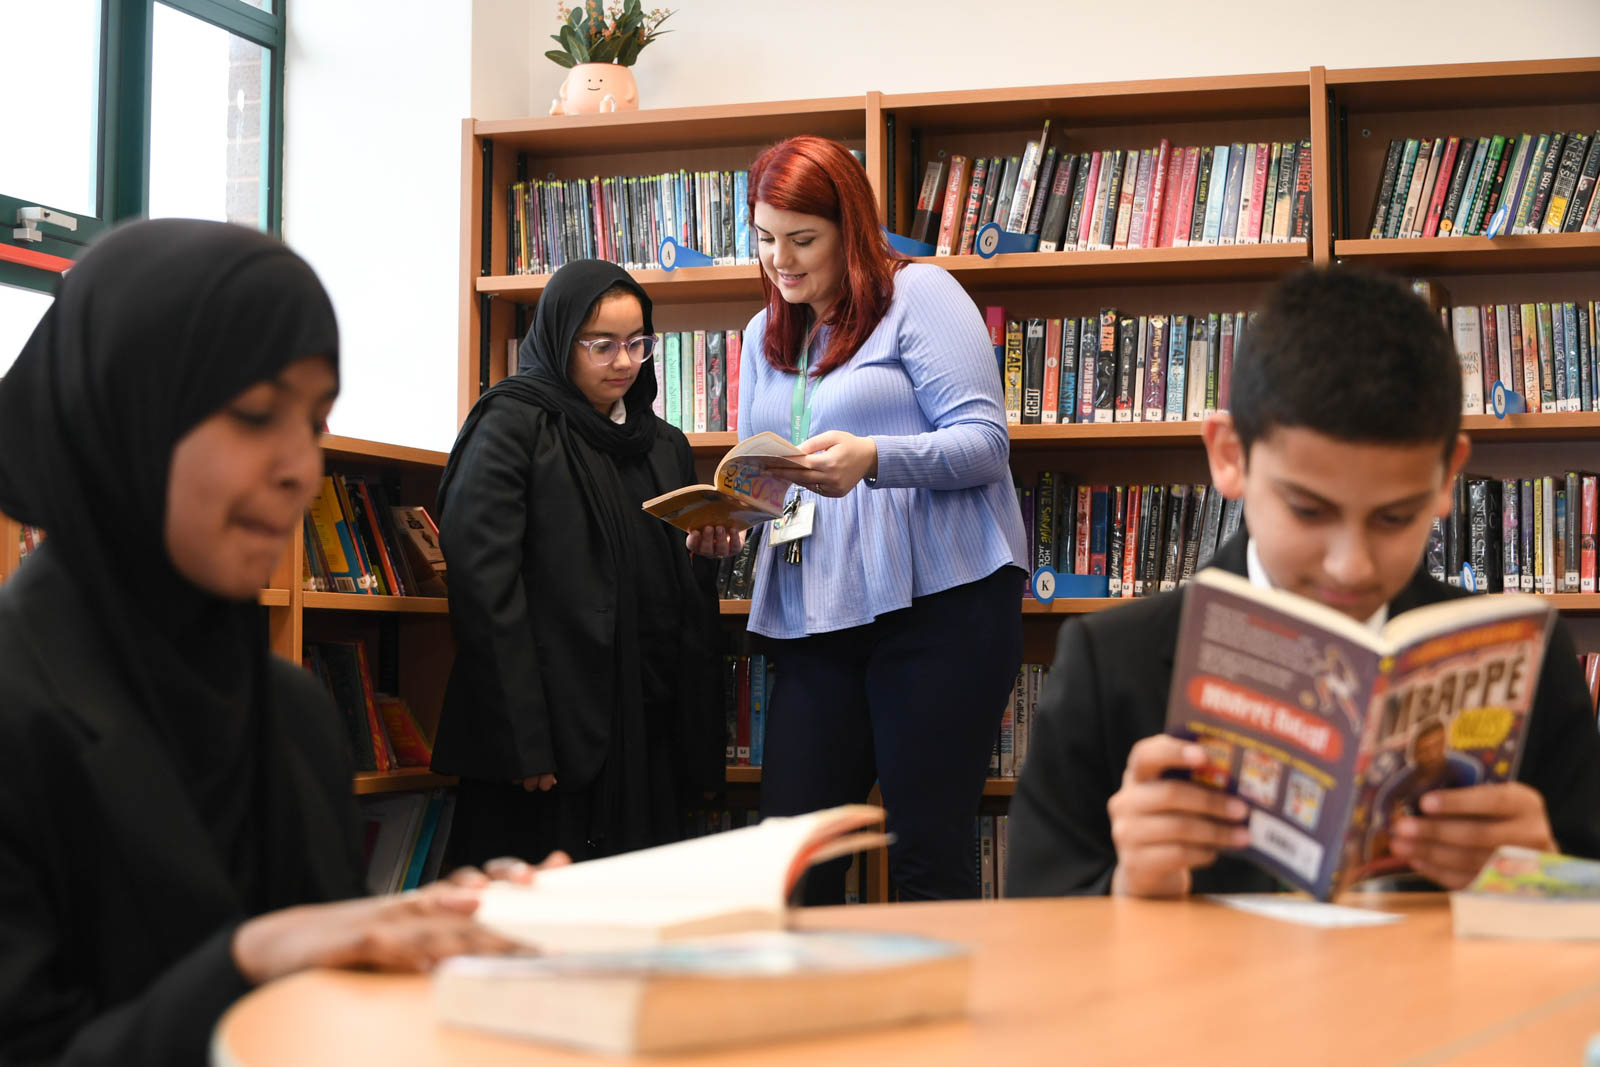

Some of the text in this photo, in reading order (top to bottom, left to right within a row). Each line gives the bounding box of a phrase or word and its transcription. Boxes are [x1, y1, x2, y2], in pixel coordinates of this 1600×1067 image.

[1558, 137, 1579, 178] NESS
[984, 235, 993, 247] G
[665, 250, 671, 260] A
[1007, 337, 1021, 371] DEAD
[1497, 394, 1503, 406] R
[1528, 384, 1536, 400] SKY
[1041, 477, 1052, 504] FIVE
[1473, 502, 1486, 577] Night Circus
[1041, 580, 1050, 591] K
[1016, 699, 1024, 723] Collided
